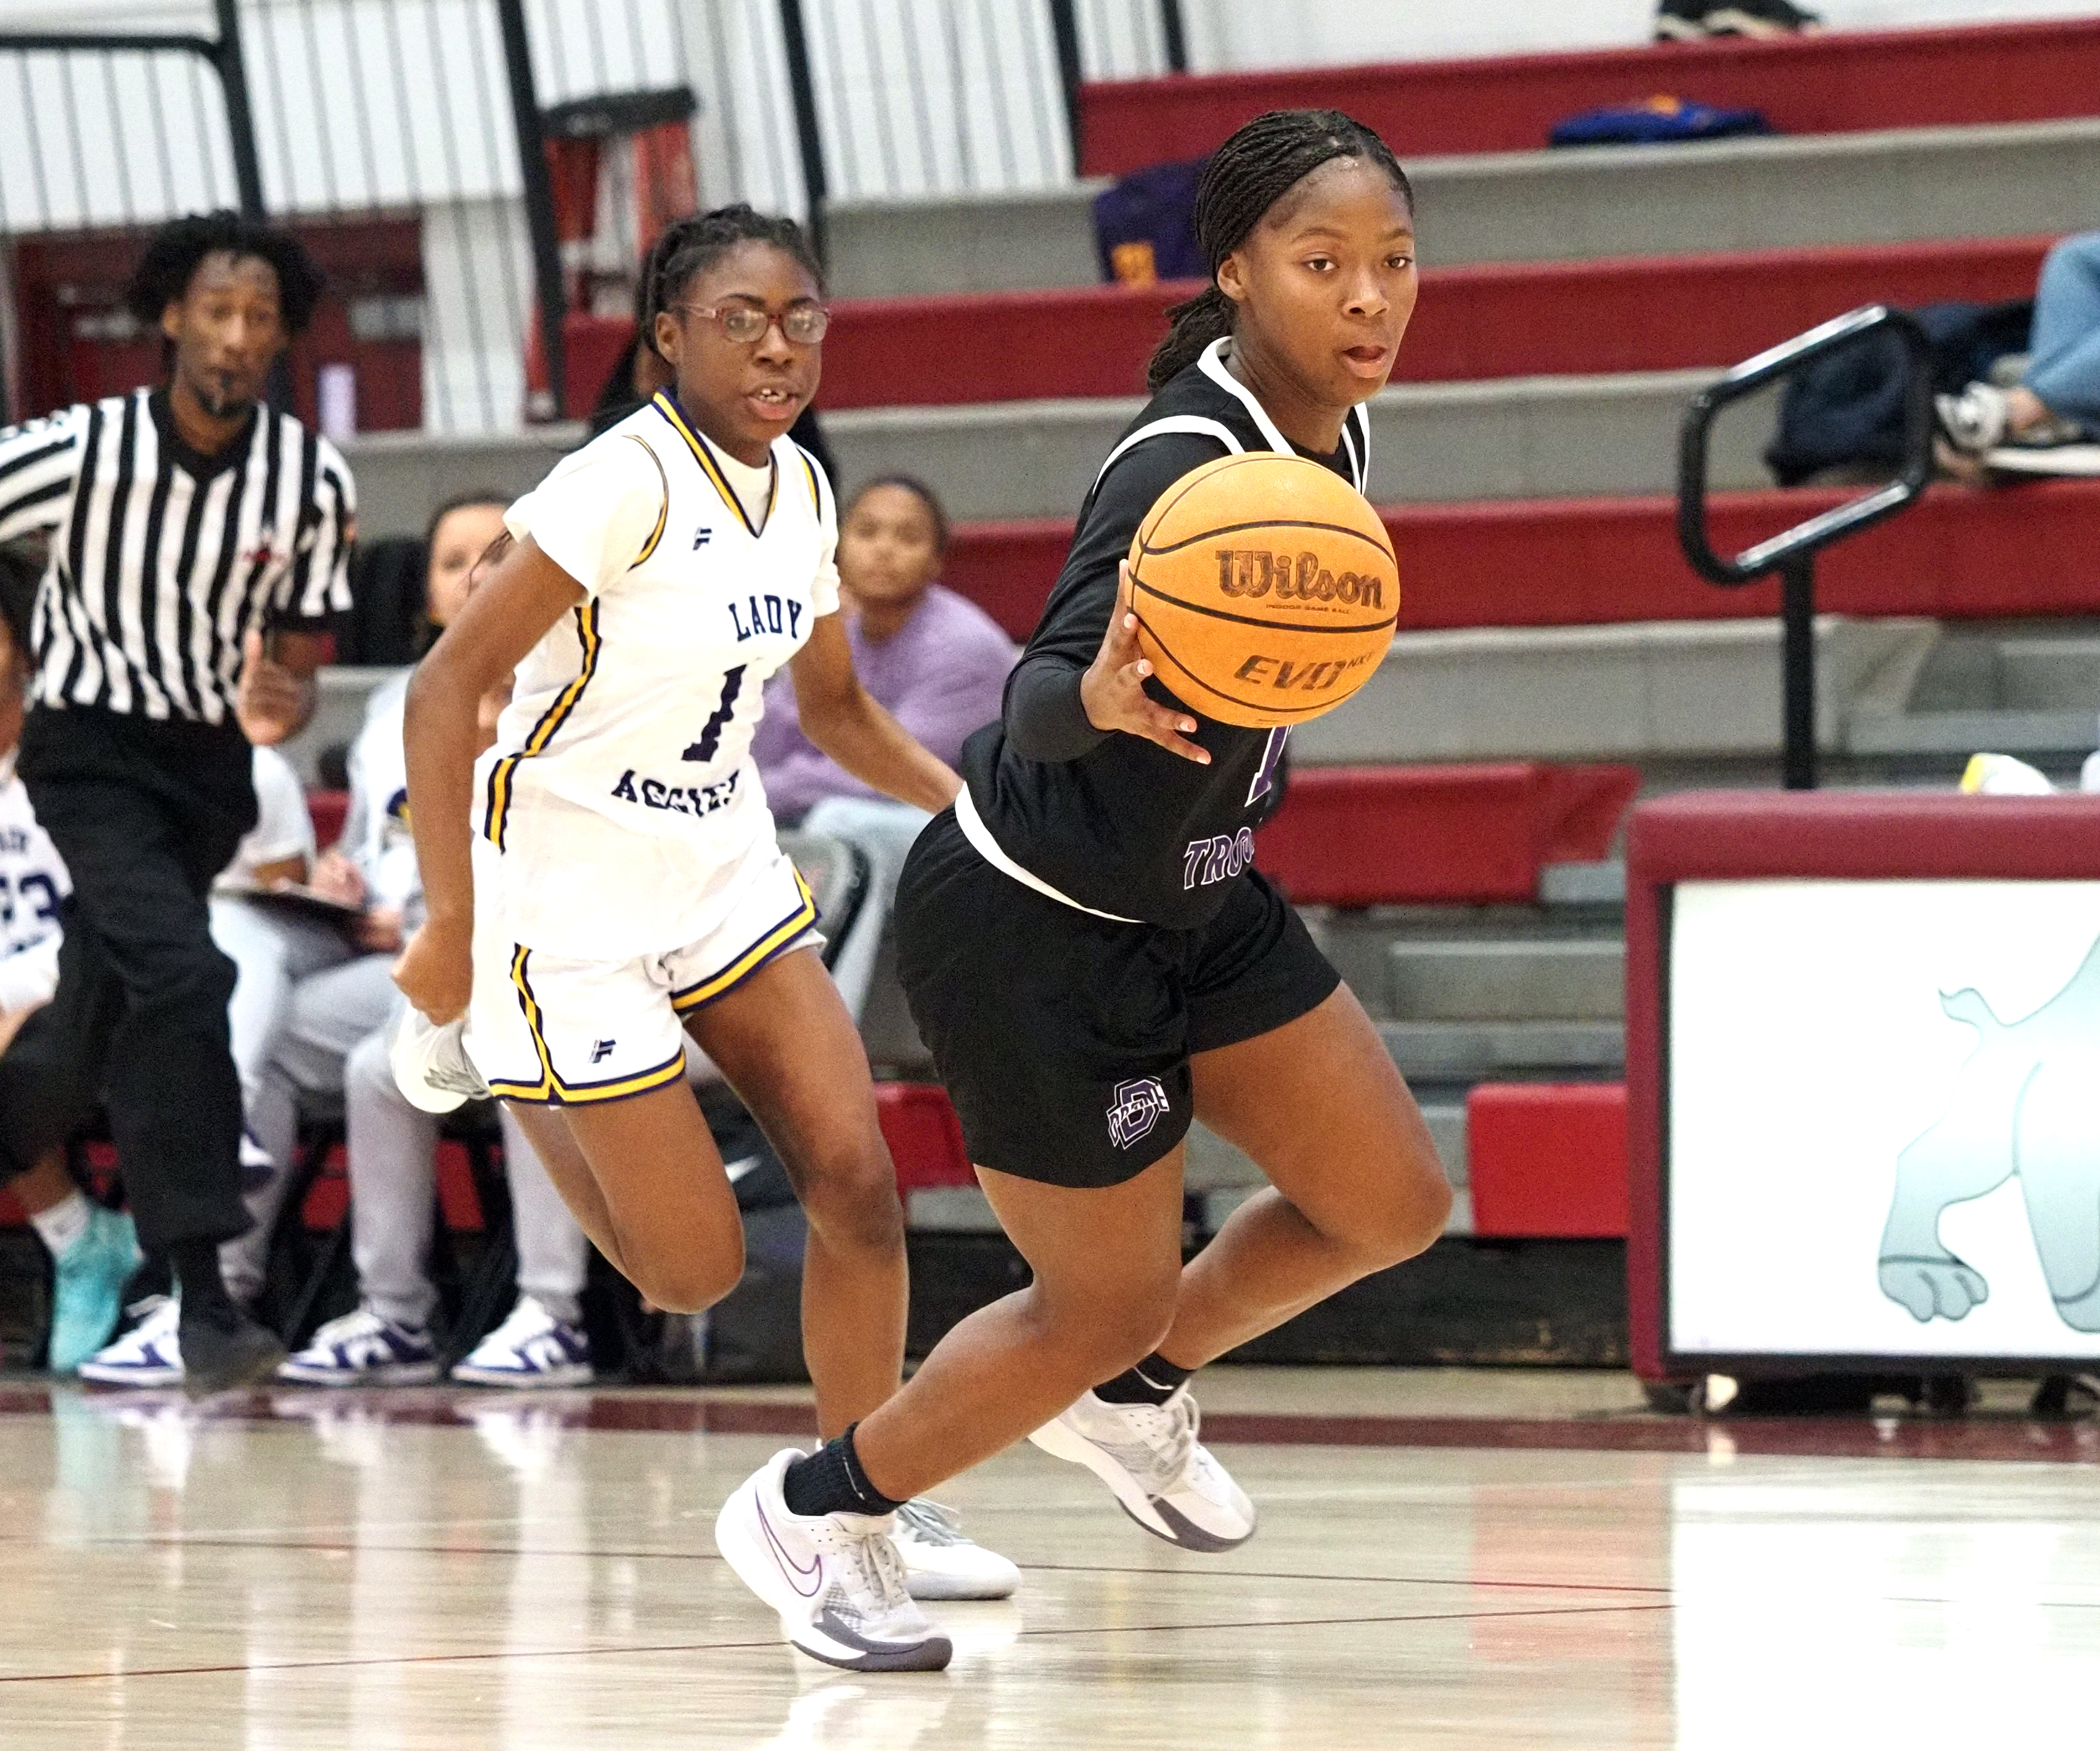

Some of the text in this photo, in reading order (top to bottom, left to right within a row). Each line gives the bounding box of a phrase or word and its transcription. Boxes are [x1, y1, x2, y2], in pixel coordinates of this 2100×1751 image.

[1215, 550, 1384, 610] Wilson
[728, 594, 802, 642] LADY
[1233, 655, 1346, 690] EVO
[680, 663, 748, 762] 1
